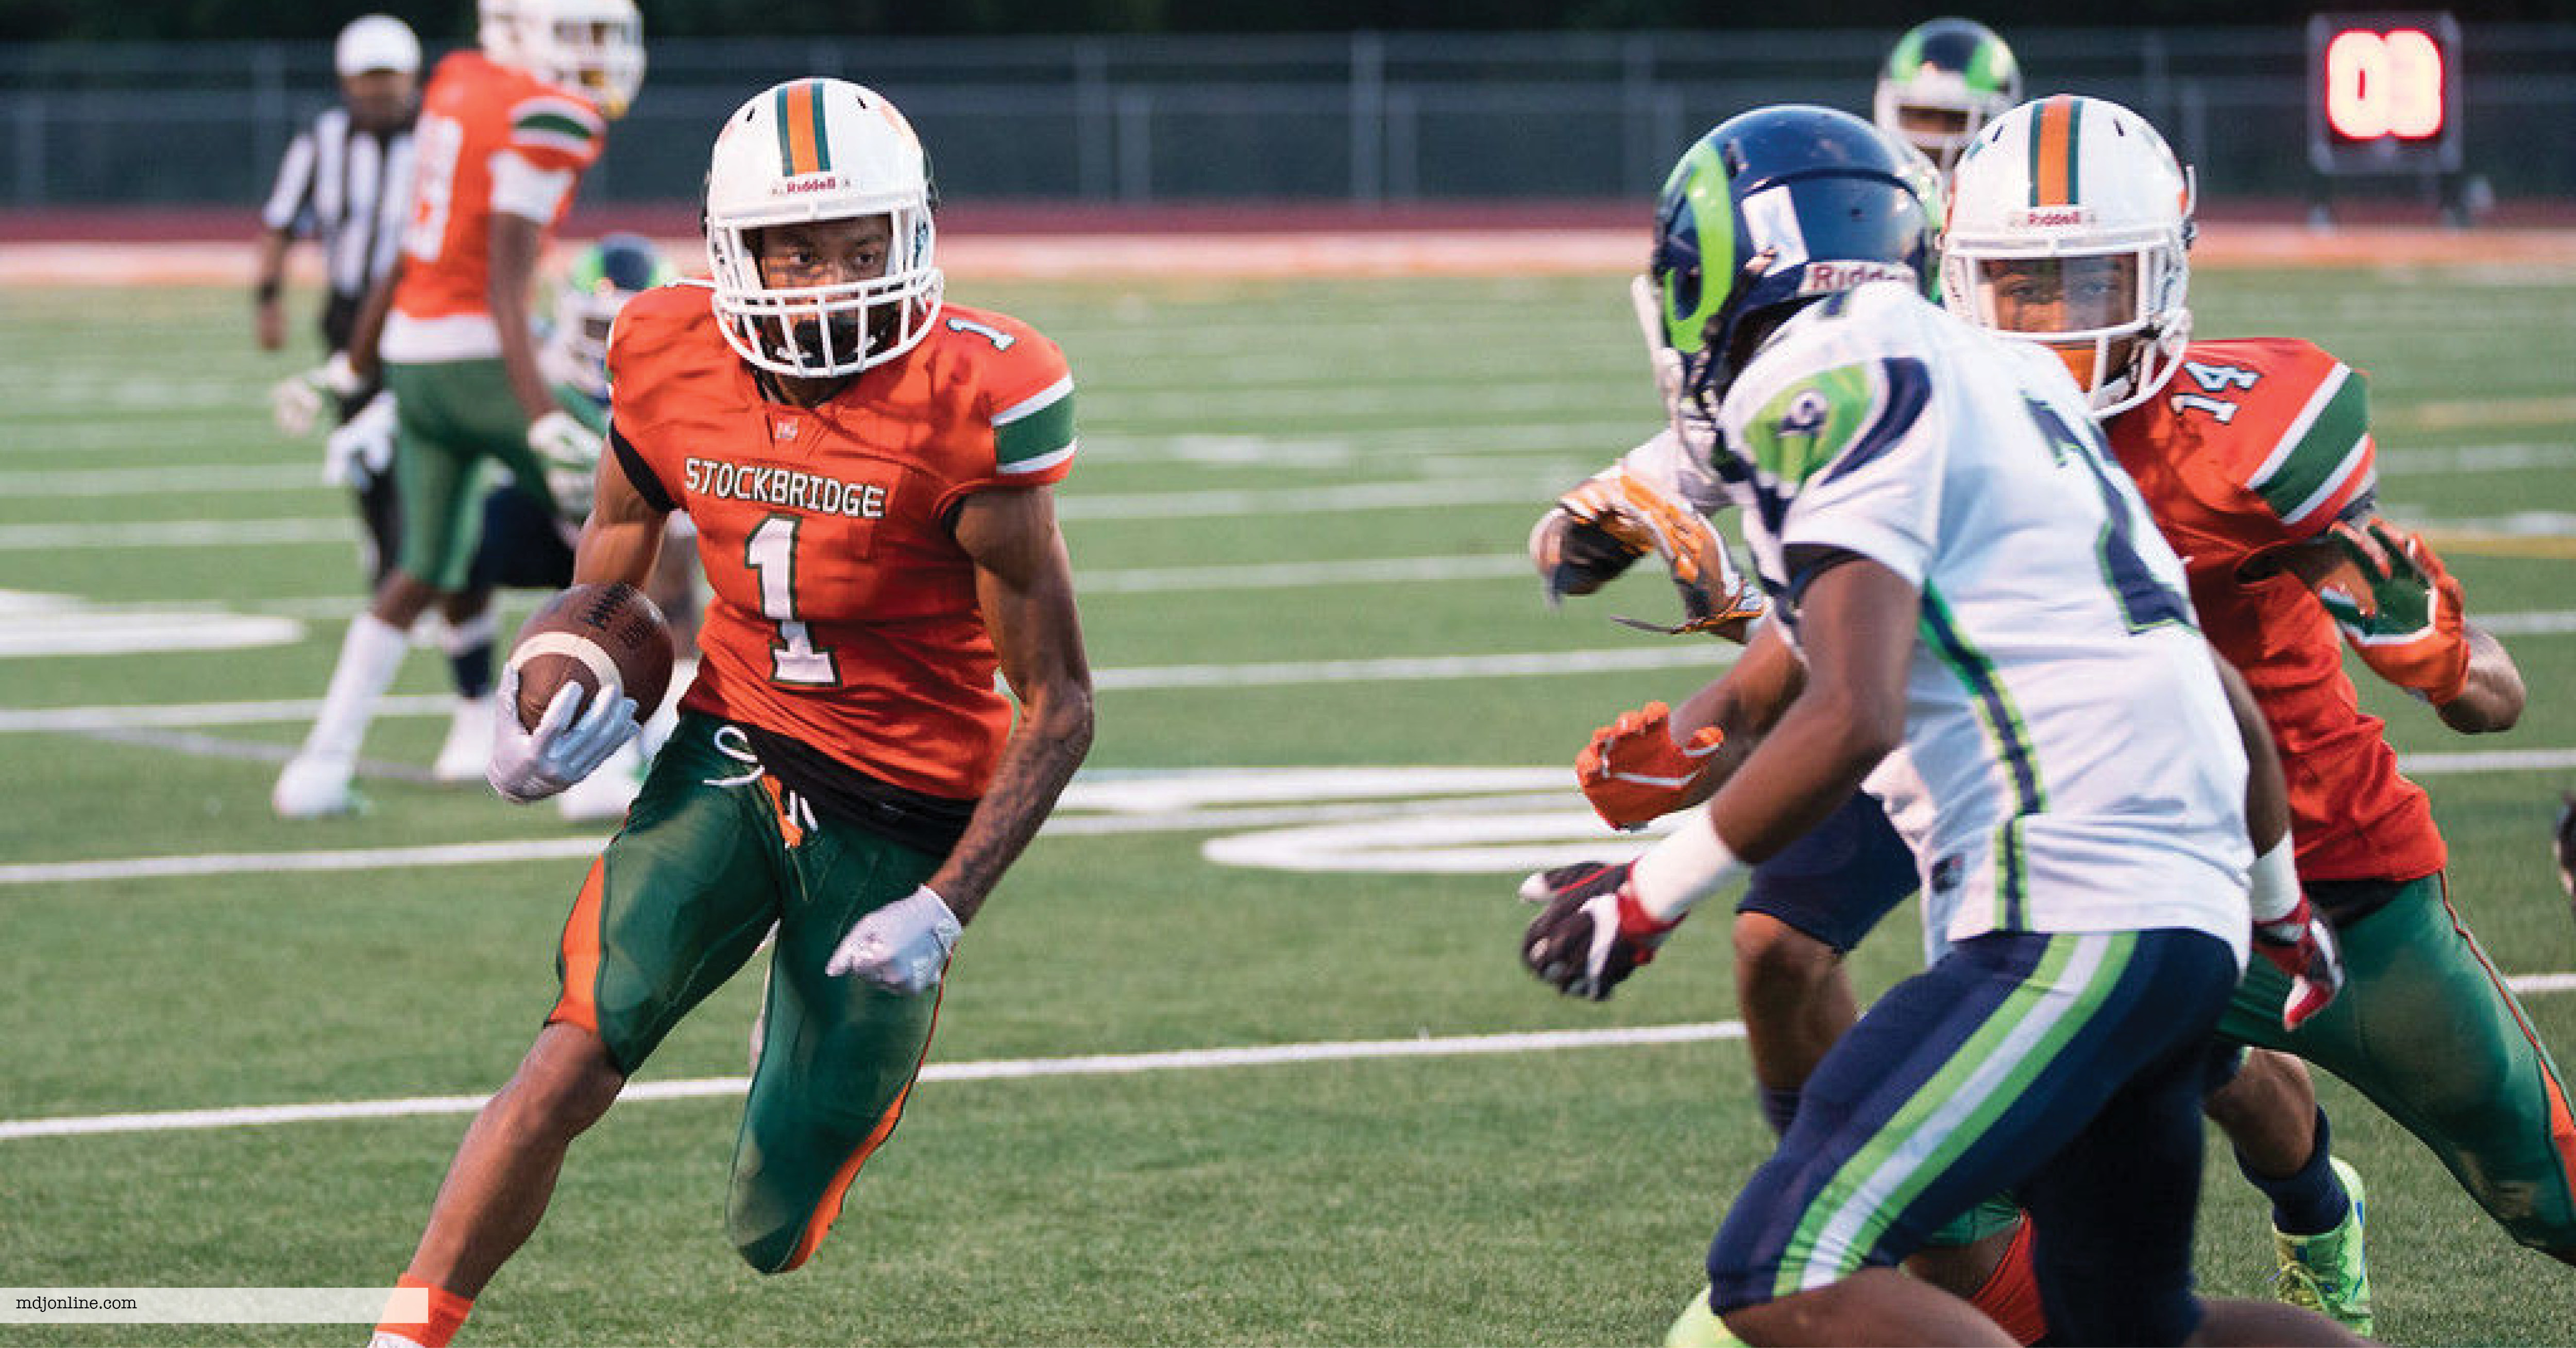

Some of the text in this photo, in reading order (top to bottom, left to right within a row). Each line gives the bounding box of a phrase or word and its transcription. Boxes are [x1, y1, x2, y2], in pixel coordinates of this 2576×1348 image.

[787, 177, 836, 194] Riddell
[1812, 264, 1906, 291] Ridd
[946, 317, 1016, 352] 1
[2170, 361, 2263, 425] 14
[684, 457, 888, 518] STOCKBRIDGE
[744, 513, 842, 688] 1
